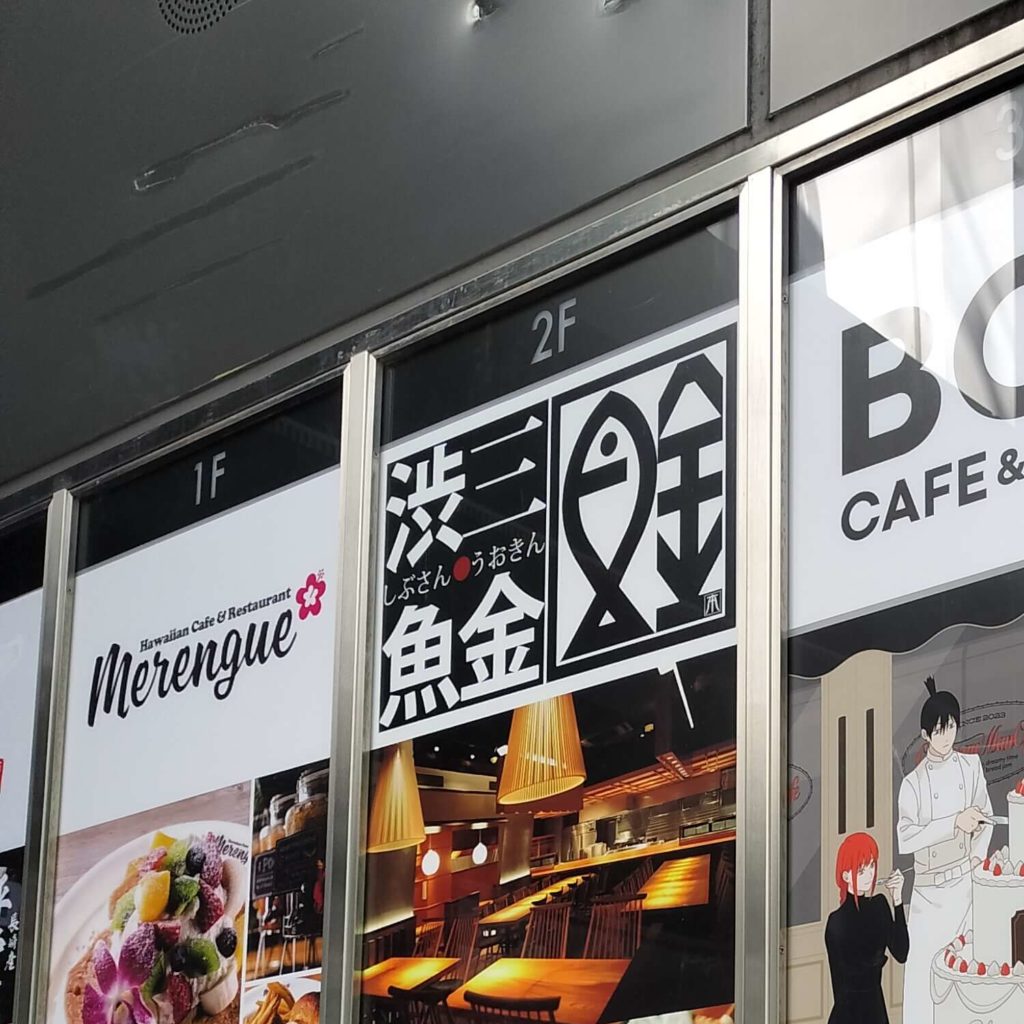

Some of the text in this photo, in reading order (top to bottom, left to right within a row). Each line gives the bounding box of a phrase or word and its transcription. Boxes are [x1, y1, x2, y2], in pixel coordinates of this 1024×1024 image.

[530, 298, 577, 365] 2F
[193, 451, 226, 505] 1F
[841, 451, 987, 541] CAFE
[997, 448, 1024, 486] &
[140, 588, 291, 653] Hawaiian Cafe & Restaurant
[379, 571, 545, 728] 魚金
[87, 609, 297, 727] Merengue
